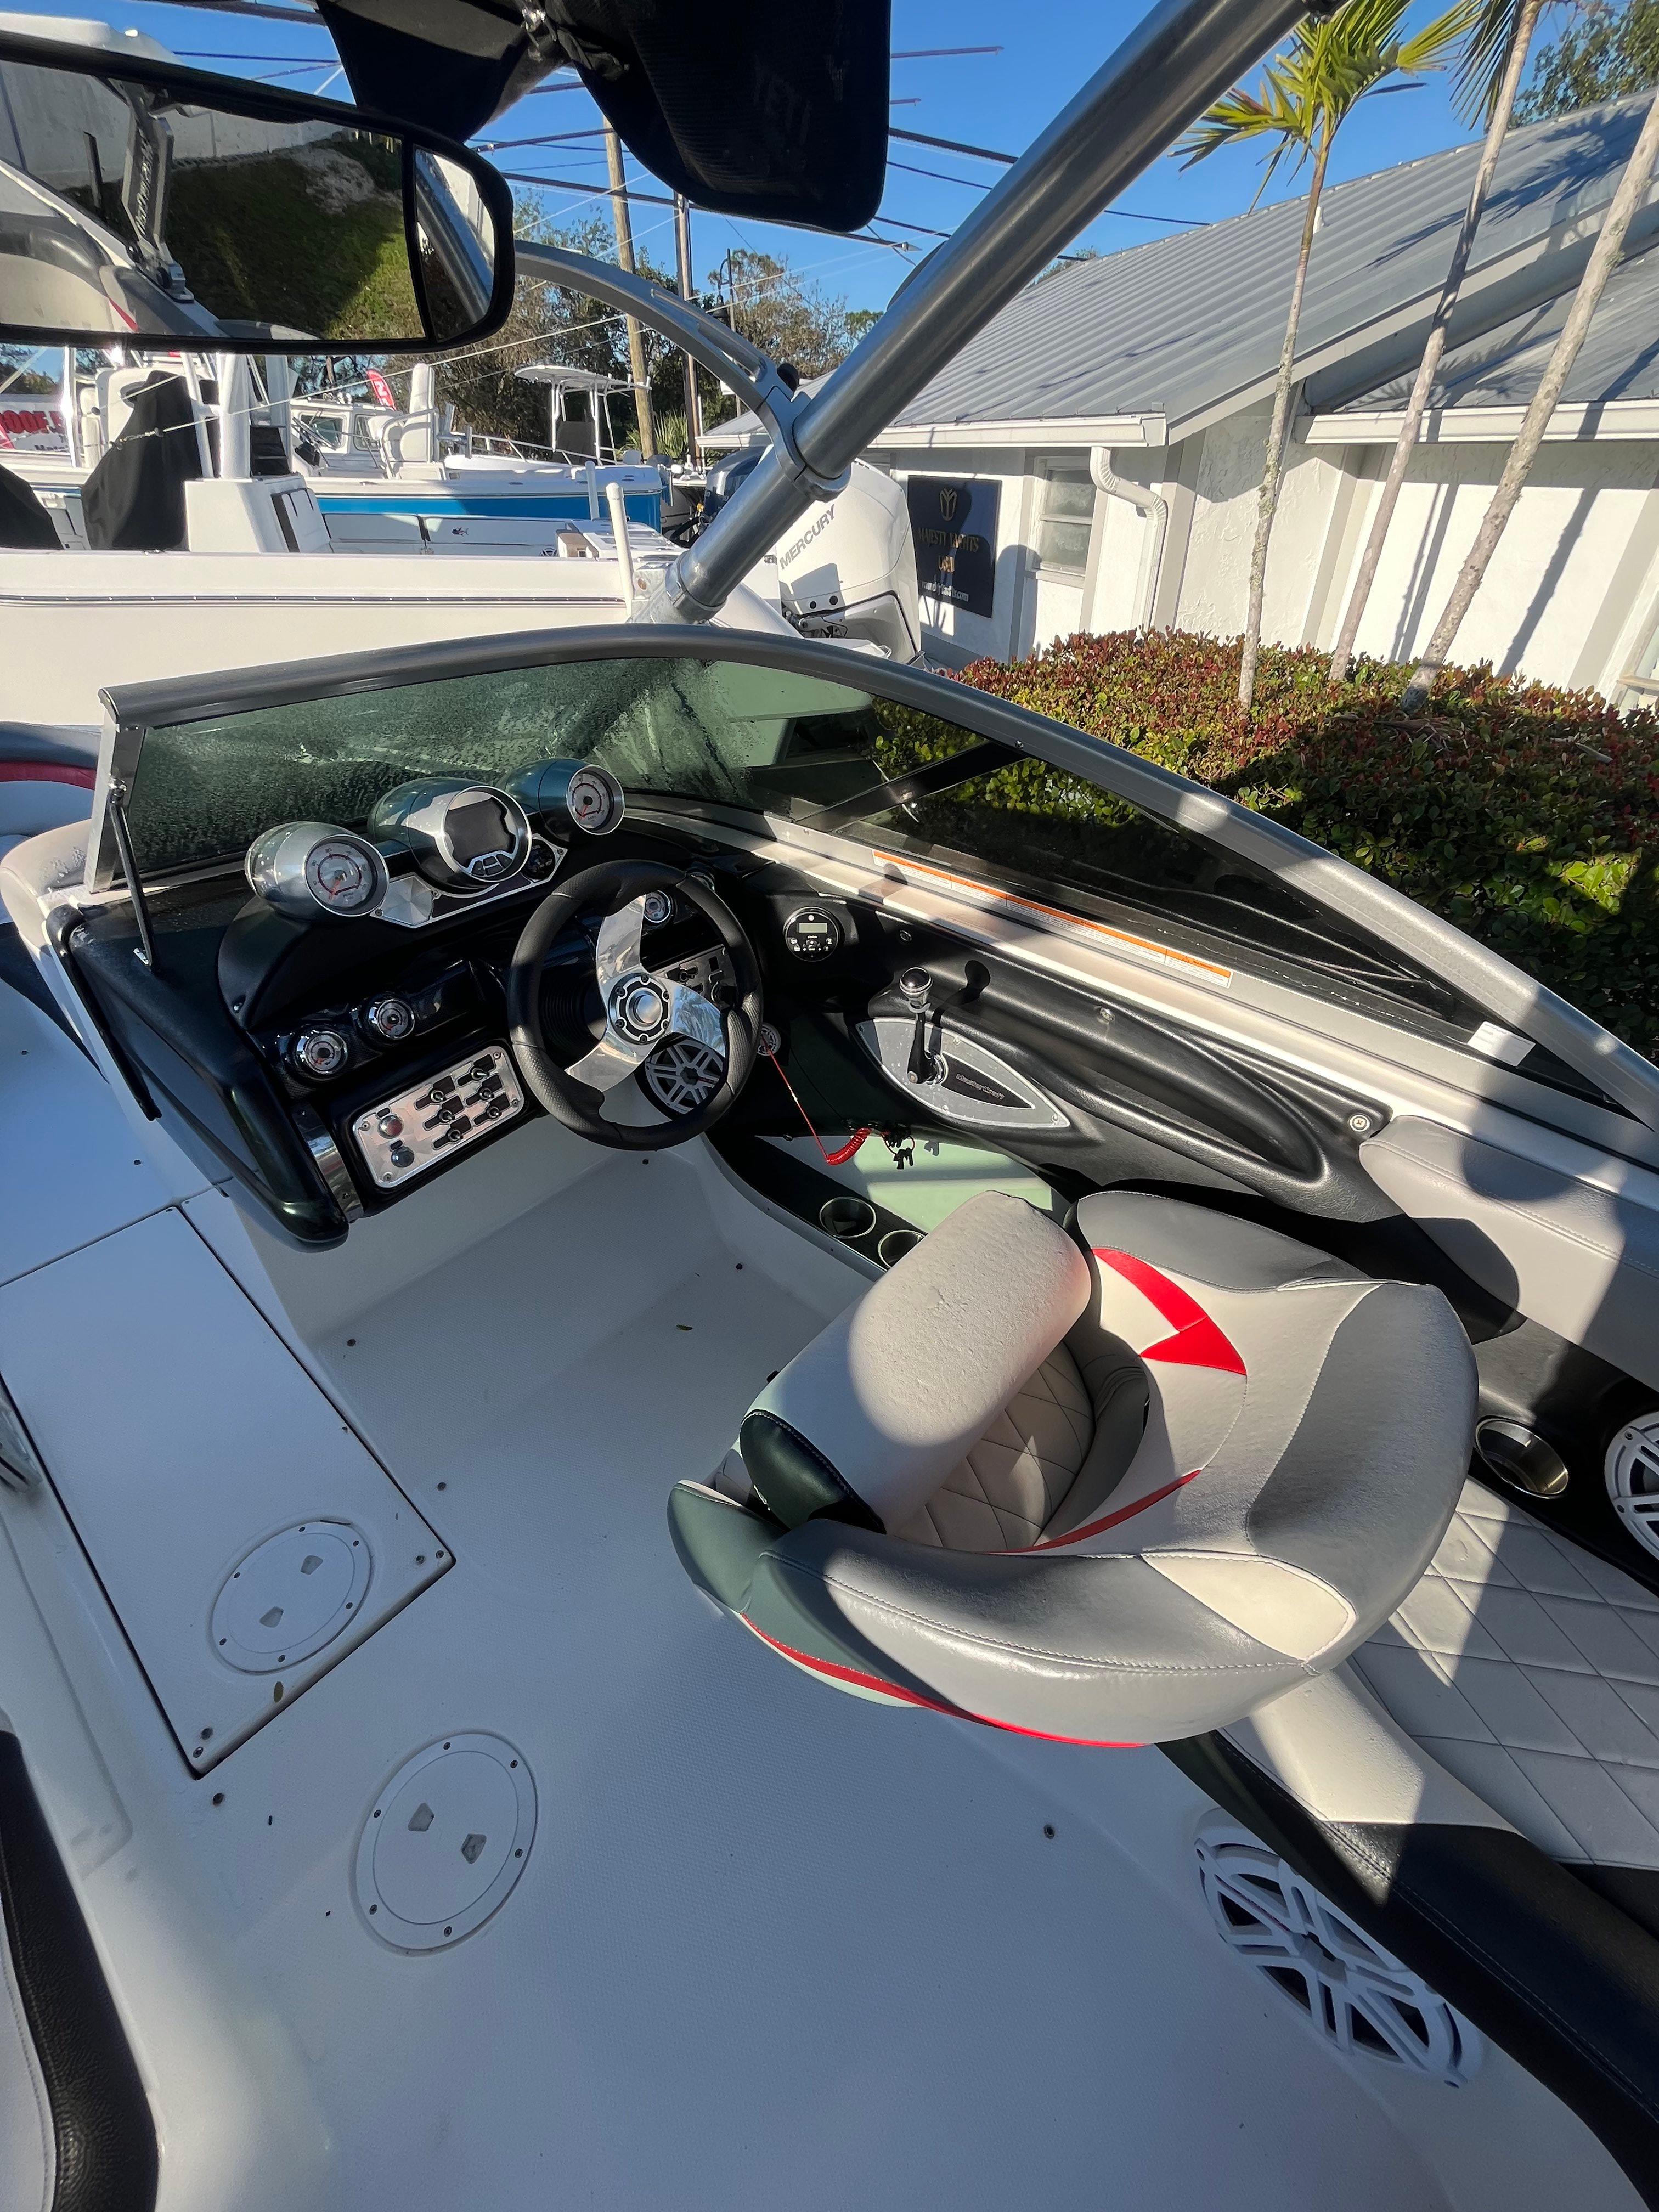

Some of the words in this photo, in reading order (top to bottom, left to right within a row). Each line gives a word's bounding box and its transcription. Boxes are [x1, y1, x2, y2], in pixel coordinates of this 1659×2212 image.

[780, 504, 834, 569] MERCURY
[918, 527, 947, 548] MAJESTY
[950, 532, 979, 553] YACHTS
